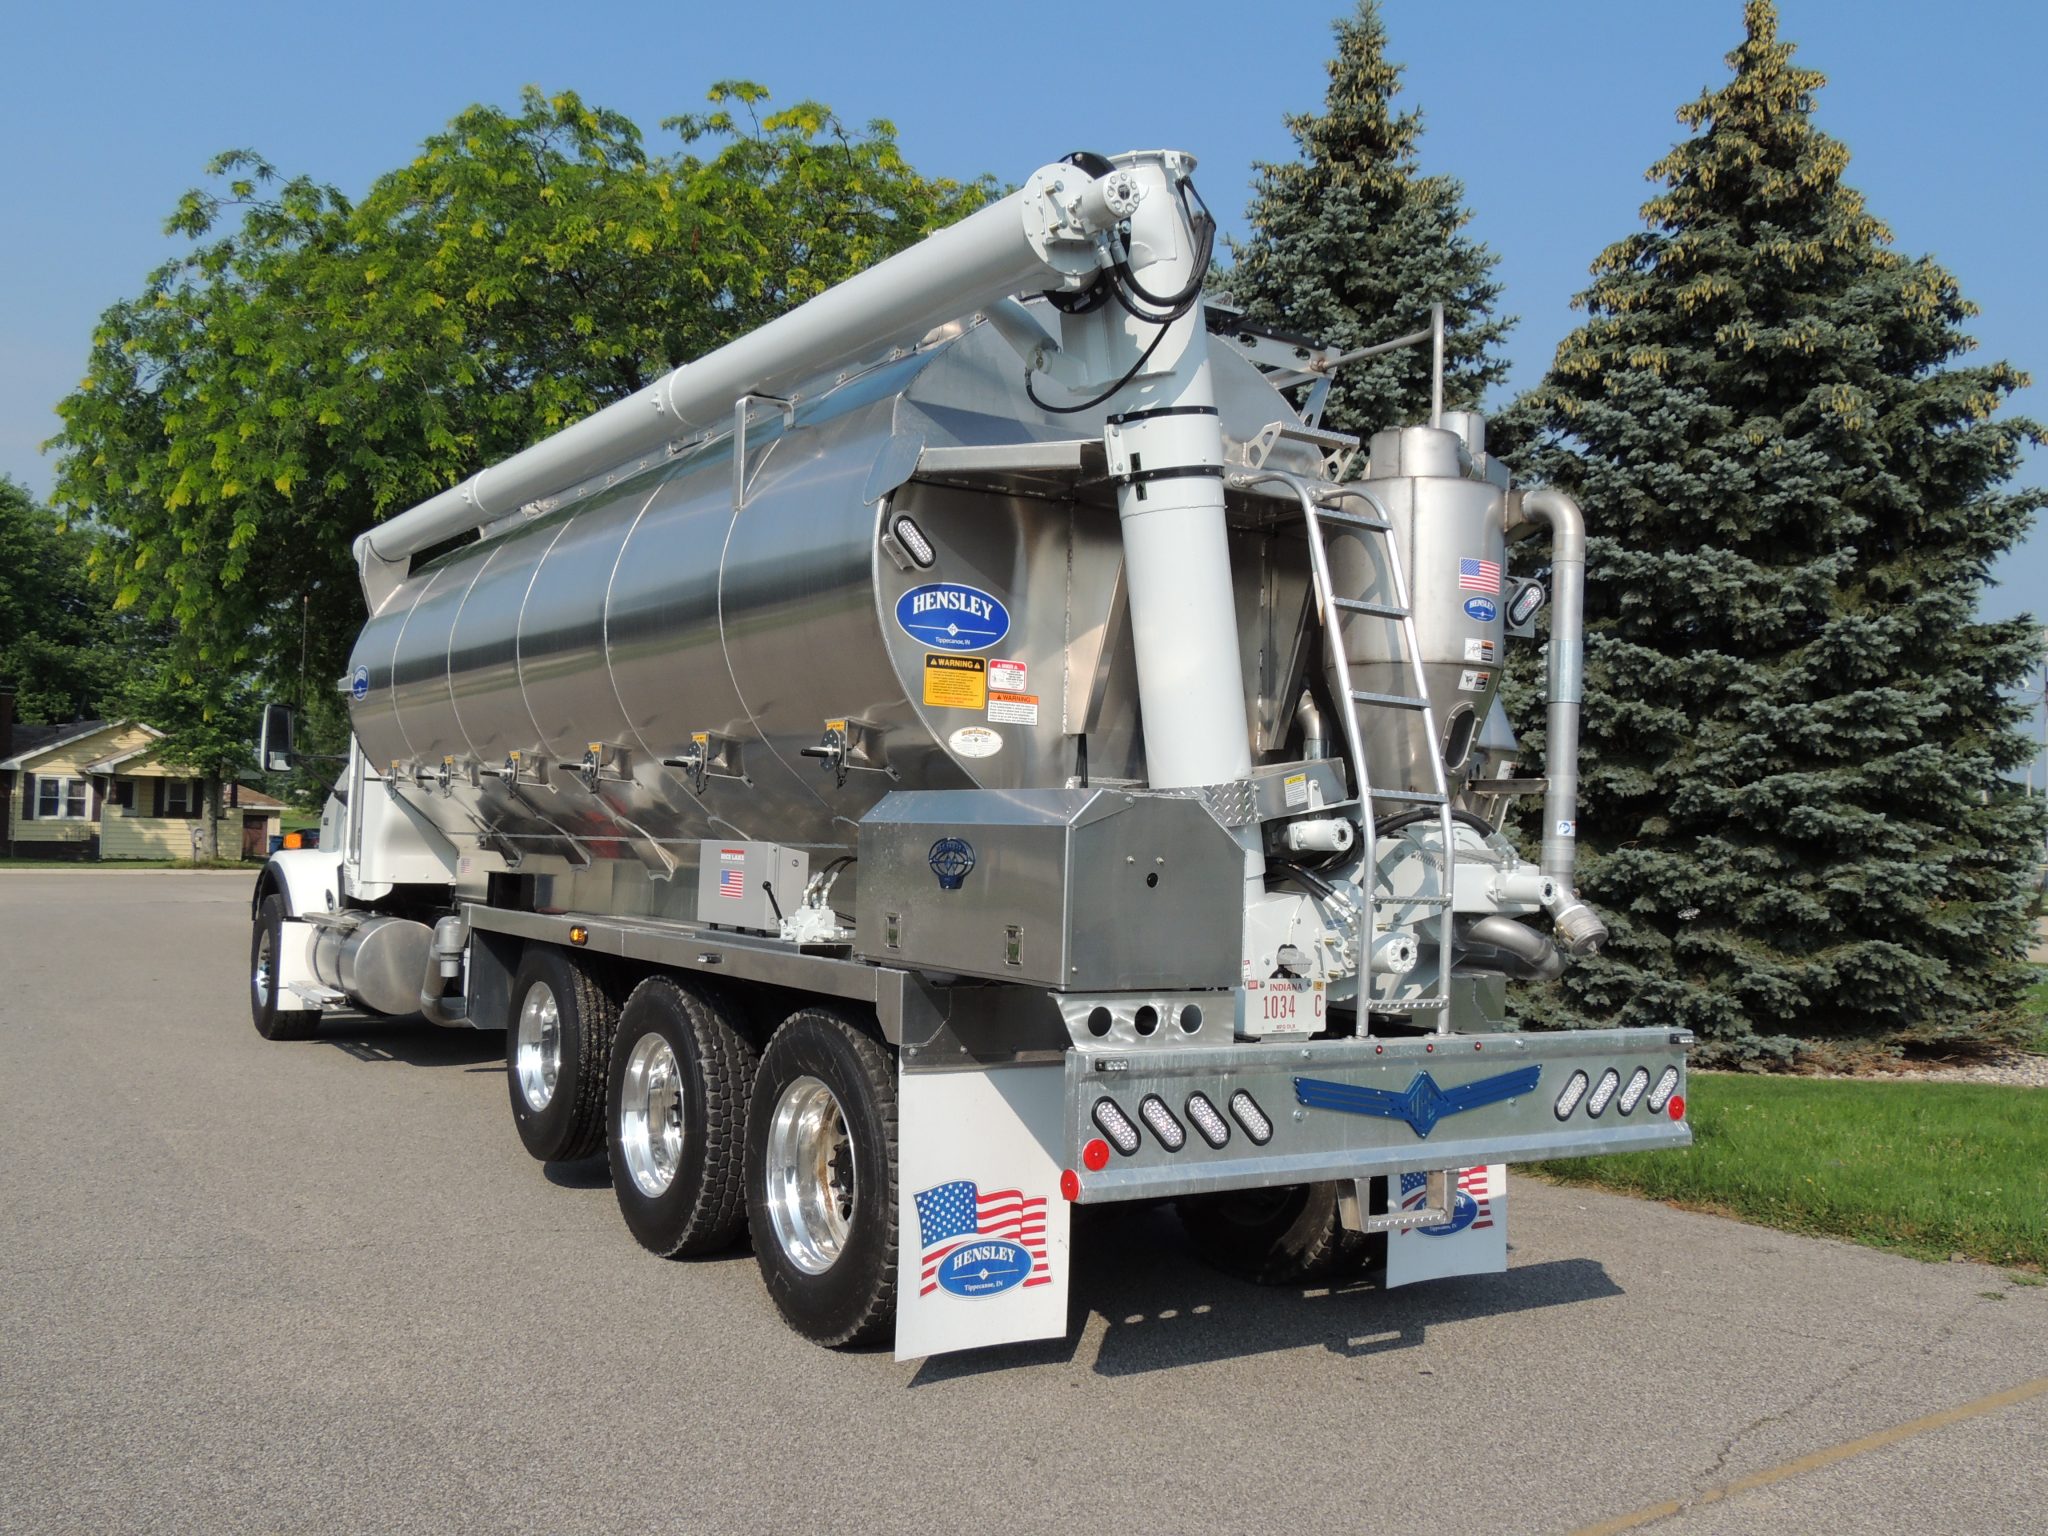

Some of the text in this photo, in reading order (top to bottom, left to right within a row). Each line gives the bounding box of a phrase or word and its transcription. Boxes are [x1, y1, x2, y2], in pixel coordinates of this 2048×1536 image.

[913, 591, 993, 620] HENSLEY
[938, 659, 973, 669] WARNING
[1003, 695, 1031, 703] WARNING
[1270, 983, 1303, 992] INDIANA
[1263, 994, 1322, 1019] 1034 C
[953, 1246, 1016, 1271] HENSLEY
